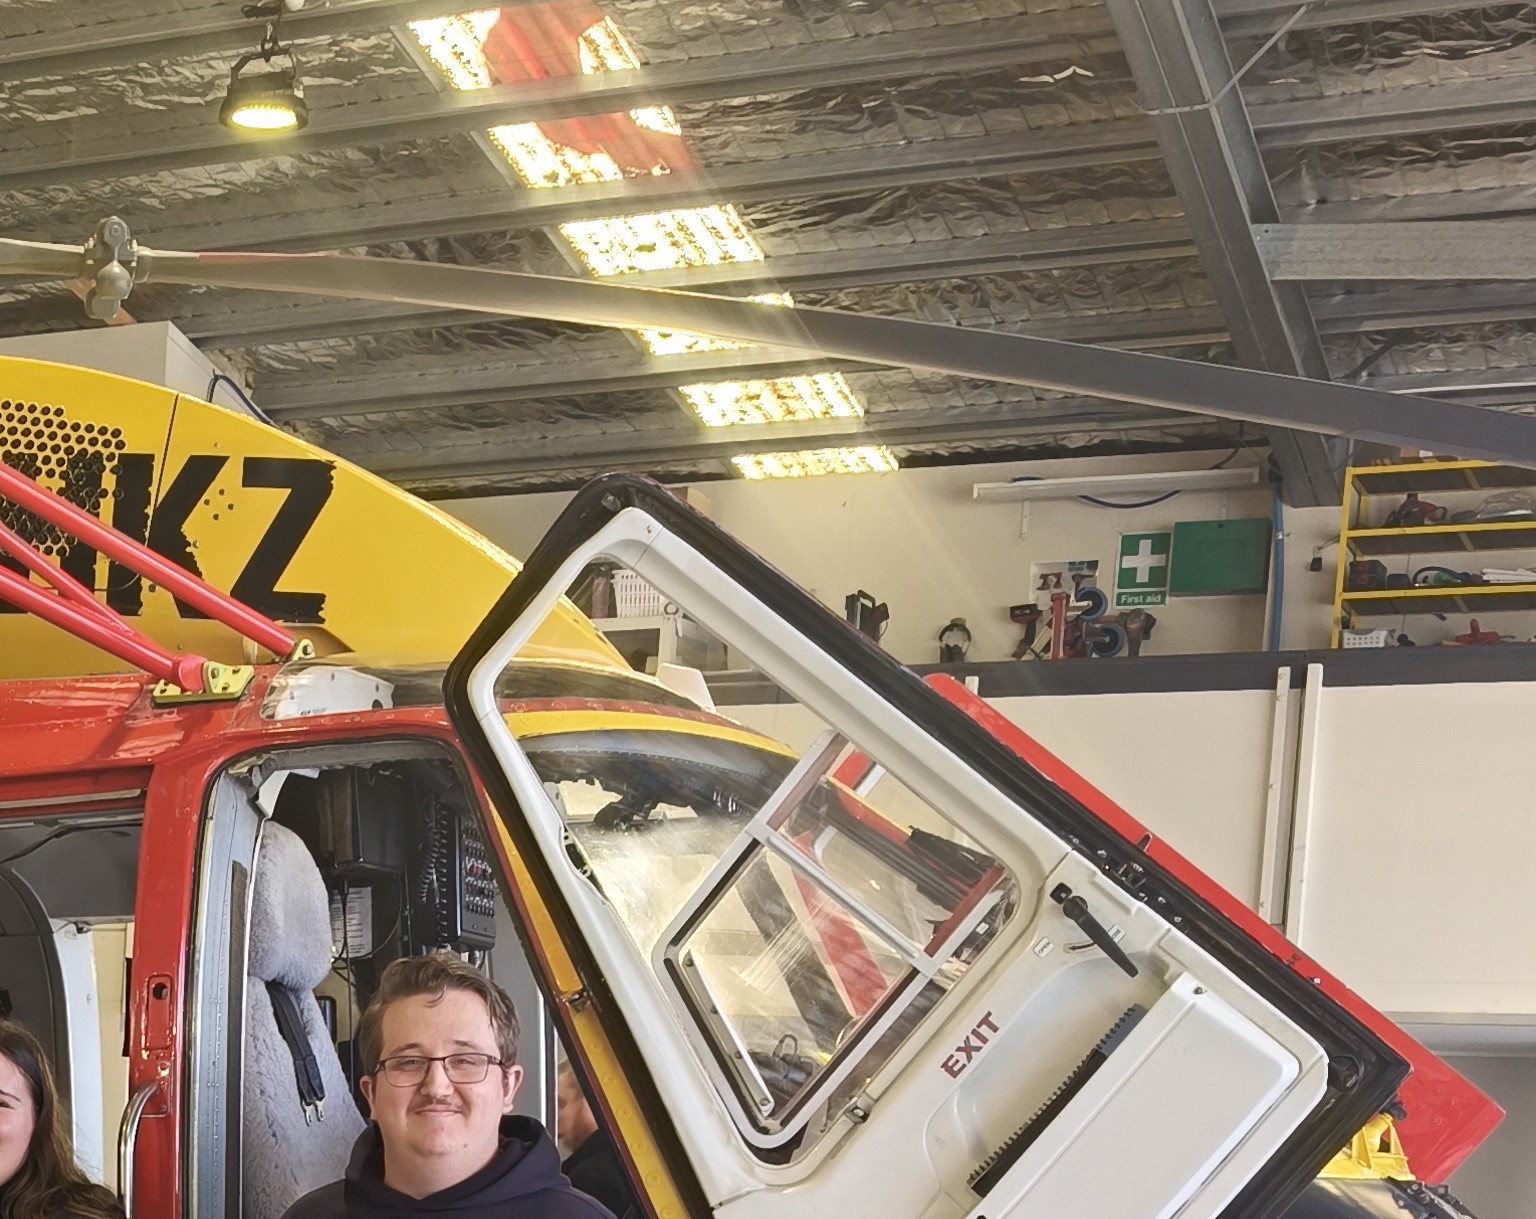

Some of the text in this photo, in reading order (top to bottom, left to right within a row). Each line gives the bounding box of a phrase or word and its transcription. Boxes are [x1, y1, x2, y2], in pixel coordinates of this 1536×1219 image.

[1120, 594, 1162, 604] First aid
[940, 1010, 1000, 1079] EXIT
